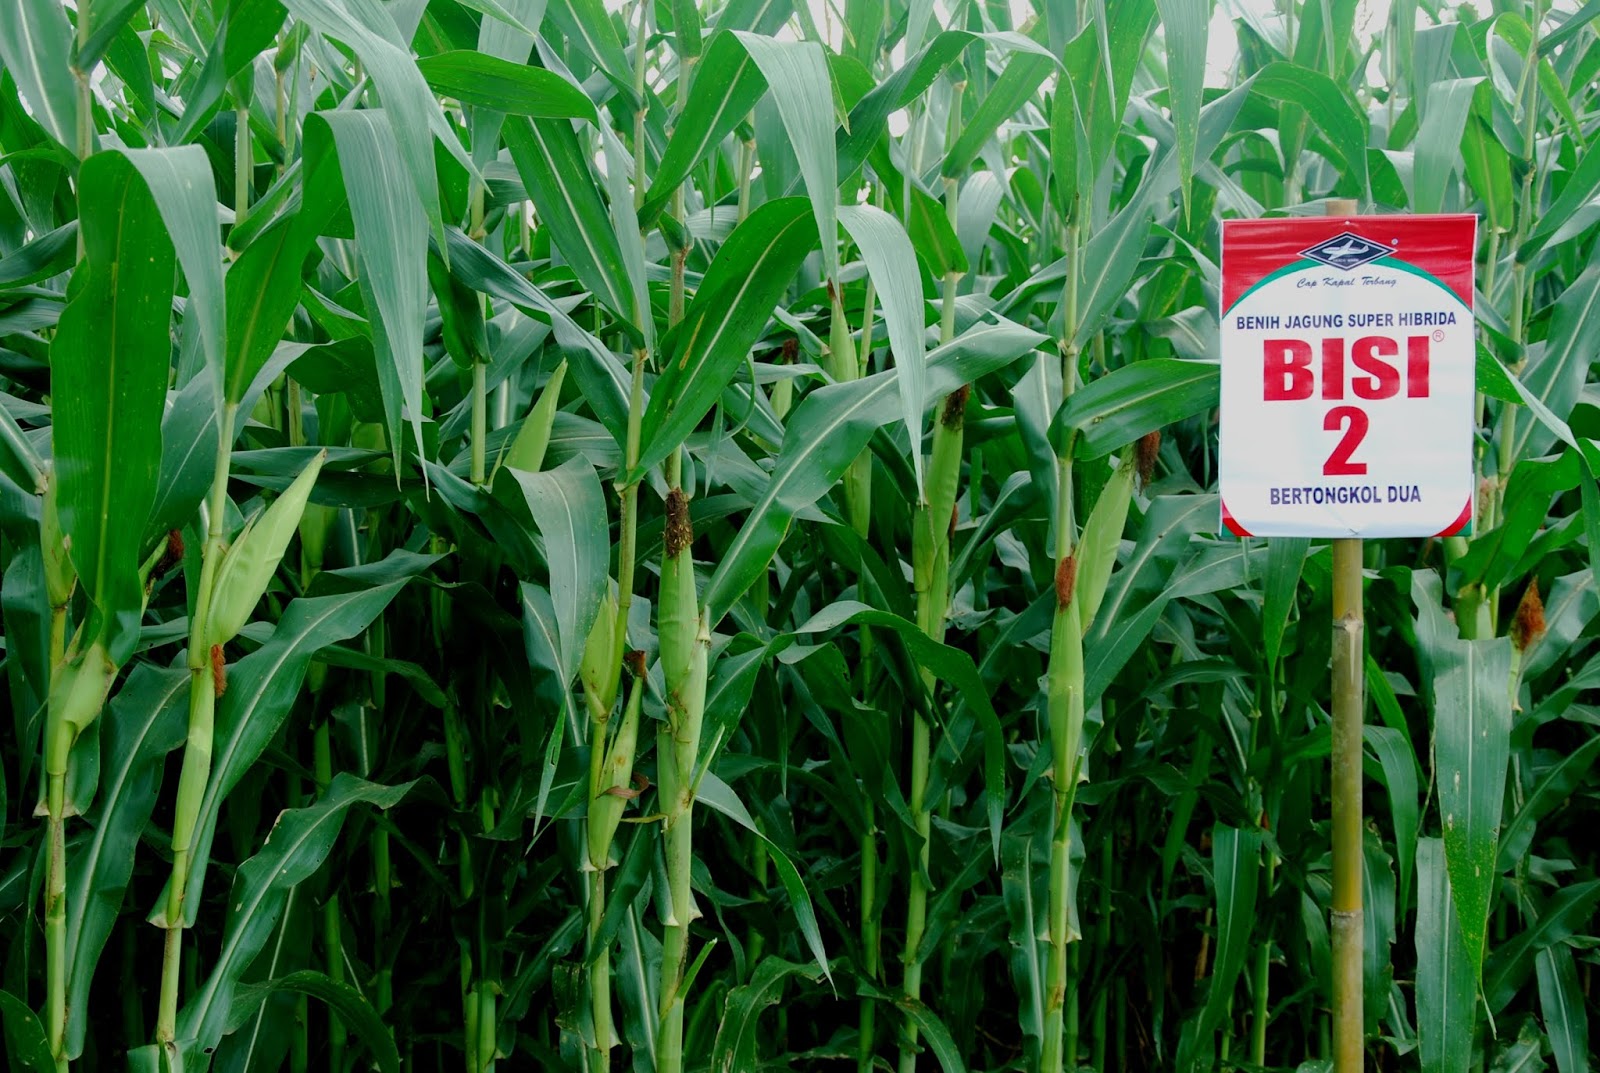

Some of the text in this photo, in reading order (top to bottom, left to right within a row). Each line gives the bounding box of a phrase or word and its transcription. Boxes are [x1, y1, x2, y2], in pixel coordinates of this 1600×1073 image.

[1296, 276, 1397, 288] Cap Kapal Terbang
[1236, 311, 1457, 330] BENIH JAGUNG SUPER HIBRIDA
[1263, 336, 1430, 401] BISI
[1322, 405, 1369, 476] 2
[1270, 485, 1421, 505] BERTONGKOL DUA
